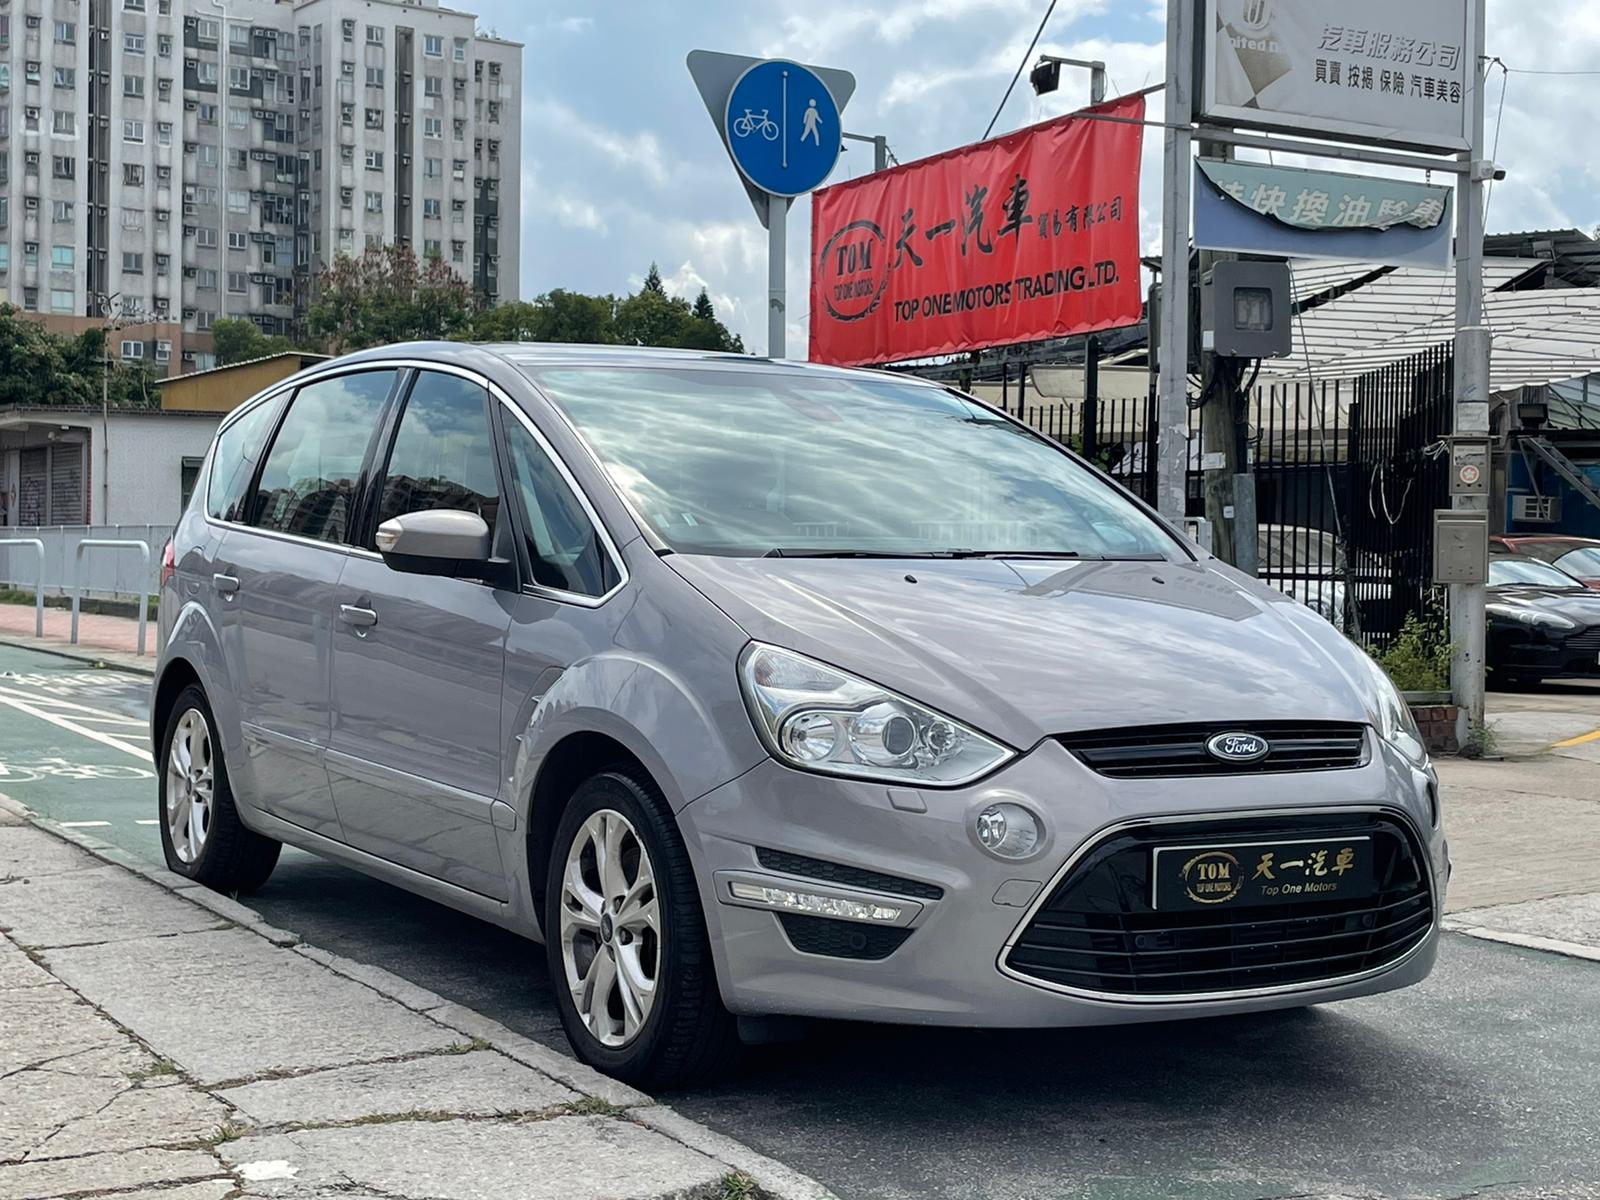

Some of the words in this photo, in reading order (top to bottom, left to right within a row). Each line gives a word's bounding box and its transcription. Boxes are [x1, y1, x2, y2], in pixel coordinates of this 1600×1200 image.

[1317, 24, 1460, 71] 汽車服務公司
[1315, 59, 1341, 85] 買賣
[1348, 64, 1373, 90] 按揭
[1380, 69, 1404, 95] 保險
[1410, 74, 1461, 104] 汽車美容
[836, 238, 873, 276] TOM
[895, 300, 919, 322] TOP
[922, 294, 952, 317] ONE
[953, 281, 1011, 313] MOTORS
[1015, 265, 1085, 301] TRADING
[1088, 259, 1119, 288] LTD.
[1224, 736, 1258, 753] Ford
[1197, 862, 1230, 880] TOM
[1252, 847, 1354, 881] 天一汽車
[1261, 885, 1279, 896] Top
[1282, 883, 1302, 894] One
[1304, 881, 1337, 893] Motors
